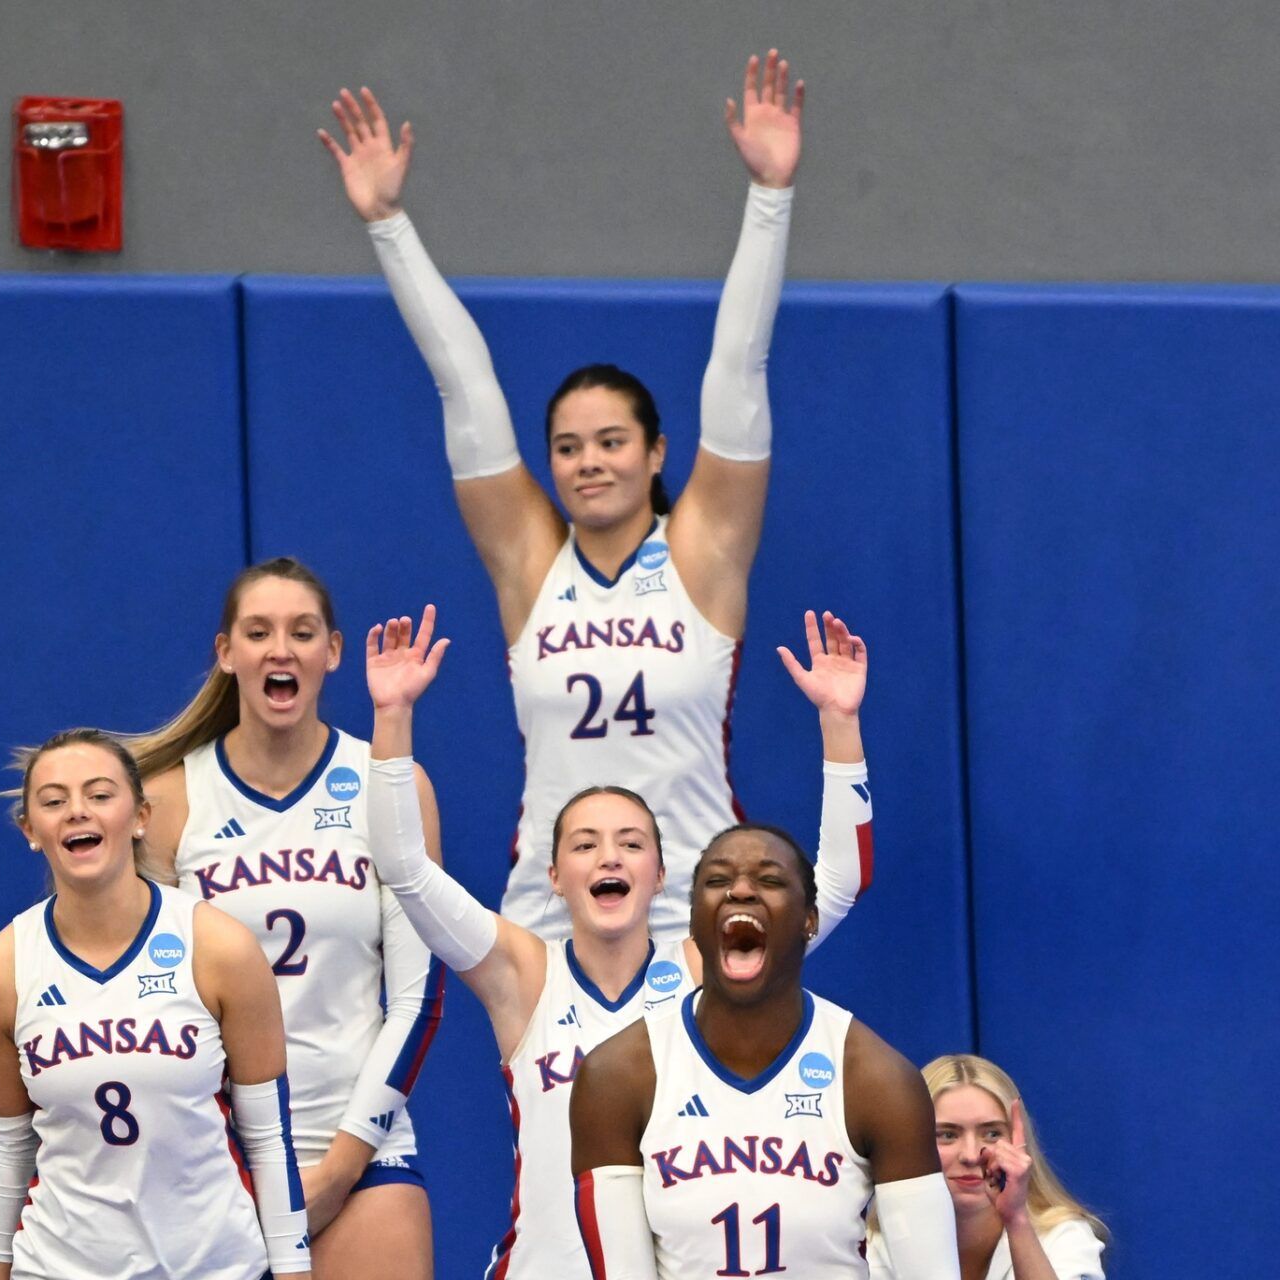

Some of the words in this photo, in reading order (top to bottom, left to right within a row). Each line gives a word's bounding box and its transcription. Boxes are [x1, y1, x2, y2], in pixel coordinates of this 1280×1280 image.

[536, 616, 685, 661] KANSAS
[566, 669, 656, 740] 24
[330, 781, 359, 792] NCAA
[195, 848, 369, 900] KANSAS
[153, 948, 183, 959] NCAA
[265, 908, 309, 976] 2
[652, 972, 681, 985] NCAA
[23, 1017, 200, 1077] KANSAS
[803, 1067, 833, 1081] NCAA
[94, 1080, 140, 1146] 8
[651, 1136, 844, 1189] KANSAS
[710, 1202, 787, 1278] 11
